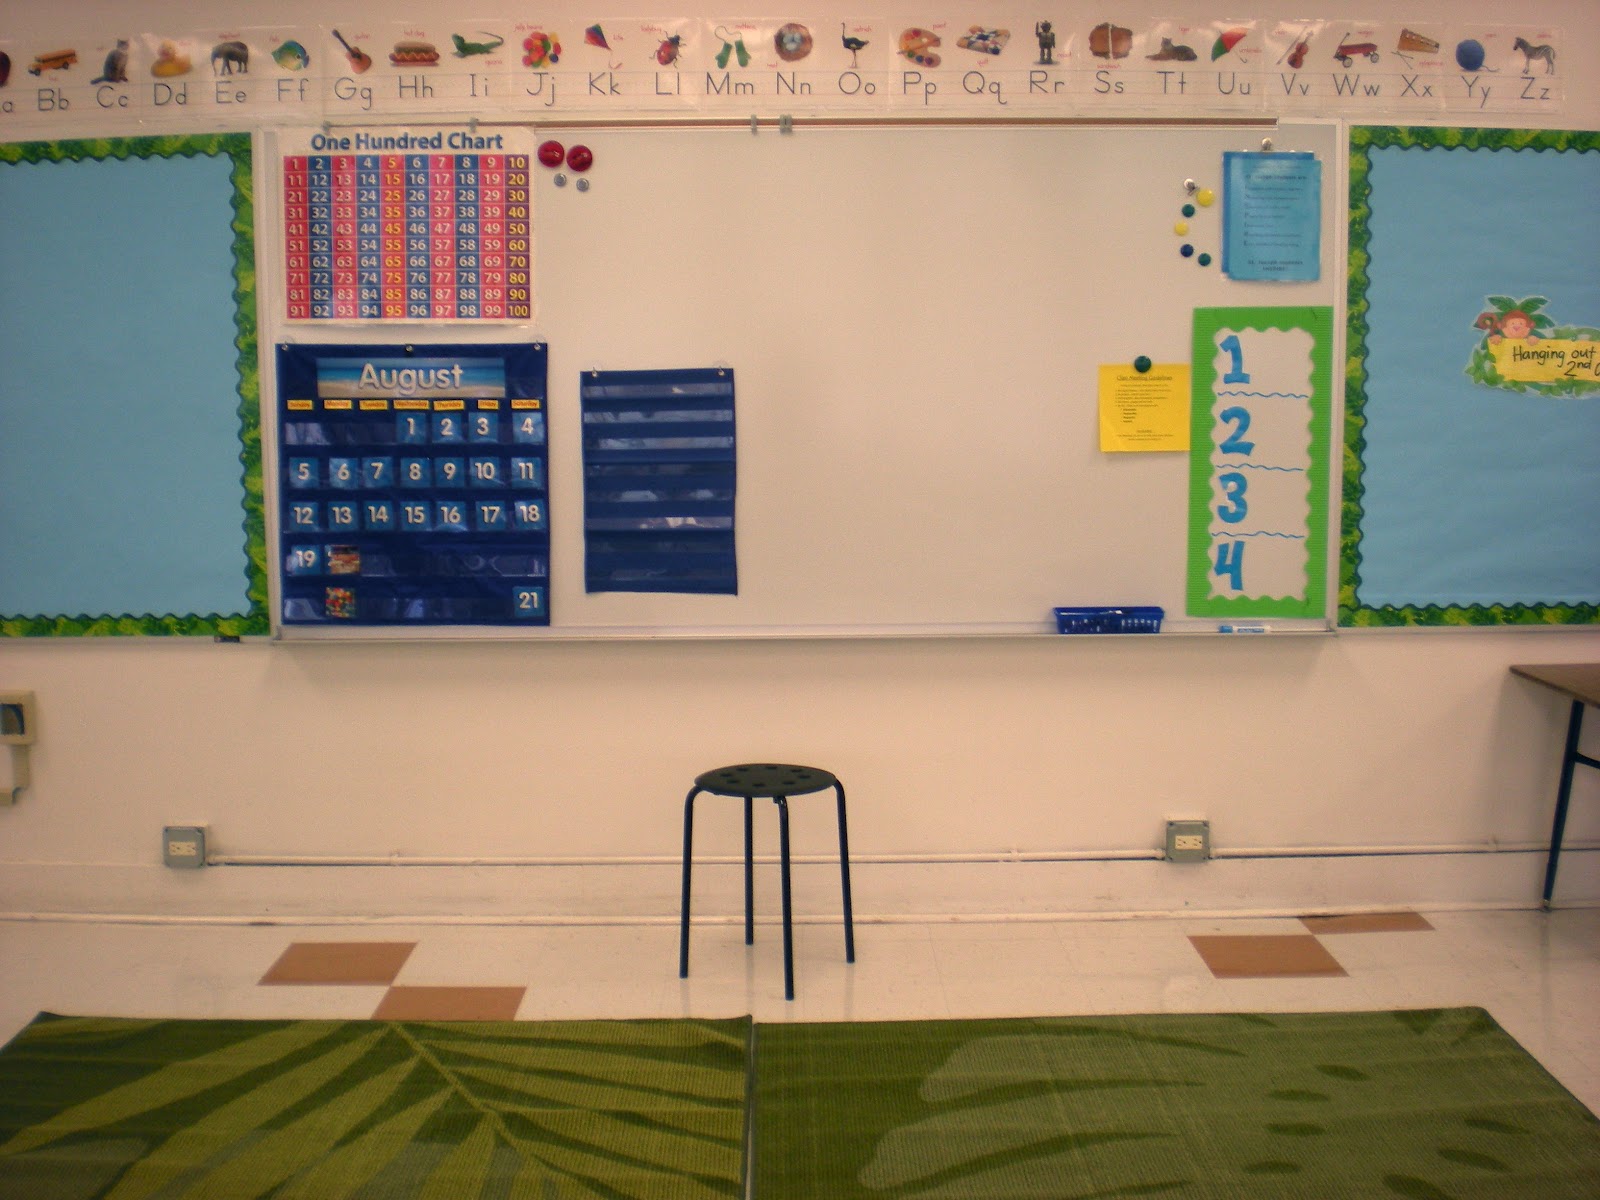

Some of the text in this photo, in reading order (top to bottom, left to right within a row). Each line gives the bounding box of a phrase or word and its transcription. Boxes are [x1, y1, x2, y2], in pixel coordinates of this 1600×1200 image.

[215, 80, 247, 104] Ee
[277, 78, 310, 101] Ff
[334, 77, 372, 110] Gg
[398, 75, 434, 98] Hh
[469, 74, 488, 97] Ii
[526, 72, 555, 106] Jj
[588, 72, 621, 96] Kk
[655, 72, 680, 96] Ll
[706, 72, 754, 95] Mm
[776, 71, 811, 94] Nn
[838, 70, 876, 94] Oo
[903, 71, 937, 105] Pp
[962, 70, 1008, 104] Qq
[1029, 70, 1065, 94] Rr
[1094, 70, 1124, 94] Ss
[1156, 71, 1187, 94] Tt
[1218, 72, 1251, 95] Uu
[1280, 73, 1310, 96] Vv
[1332, 74, 1381, 96] Ww
[1400, 74, 1434, 97] Xx
[1461, 76, 1492, 109] Yy
[1520, 76, 1550, 100] Zz
[38, 88, 69, 112] Bb
[96, 86, 129, 108] Cc
[154, 82, 188, 106] Dd
[311, 132, 503, 151] One Hundred Chart
[292, 156, 525, 169] 1 2 4 5 6 7 8 9 10
[312, 173, 525, 185] 12 14 15 16 17 18 19 20
[312, 190, 526, 202] 22 24 25 26 27 28 29 30
[312, 206, 526, 219] 32 34 35 36 37 38 39 40
[312, 223, 526, 235] 42 44 45 46 47 48 49 50
[313, 239, 526, 251] 52 54 55 56 57 58 59 60
[313, 255, 526, 268] 62 64 65 66 67 68 69 70
[313, 272, 526, 284] 72 74 75 76 77 78 79 80
[314, 288, 526, 299] 82 84 85 86 87 88 89 90
[314, 305, 528, 317] 92 94 95 96 97 98 99 100
[1219, 335, 1250, 384] 1
[1512, 345, 1597, 368] Hanging out
[359, 362, 464, 395] August
[1563, 360, 1592, 377] 2nd
[407, 418, 533, 435] 1 2 3 4
[1219, 406, 1255, 456] 2
[298, 463, 533, 480] 5 6 7 8 9 10 11
[1217, 472, 1248, 523] 3
[294, 505, 540, 524] 12 13 14 15 16 17 18
[295, 550, 315, 567] 19
[1213, 540, 1245, 591] 4
[519, 593, 538, 609] 21
